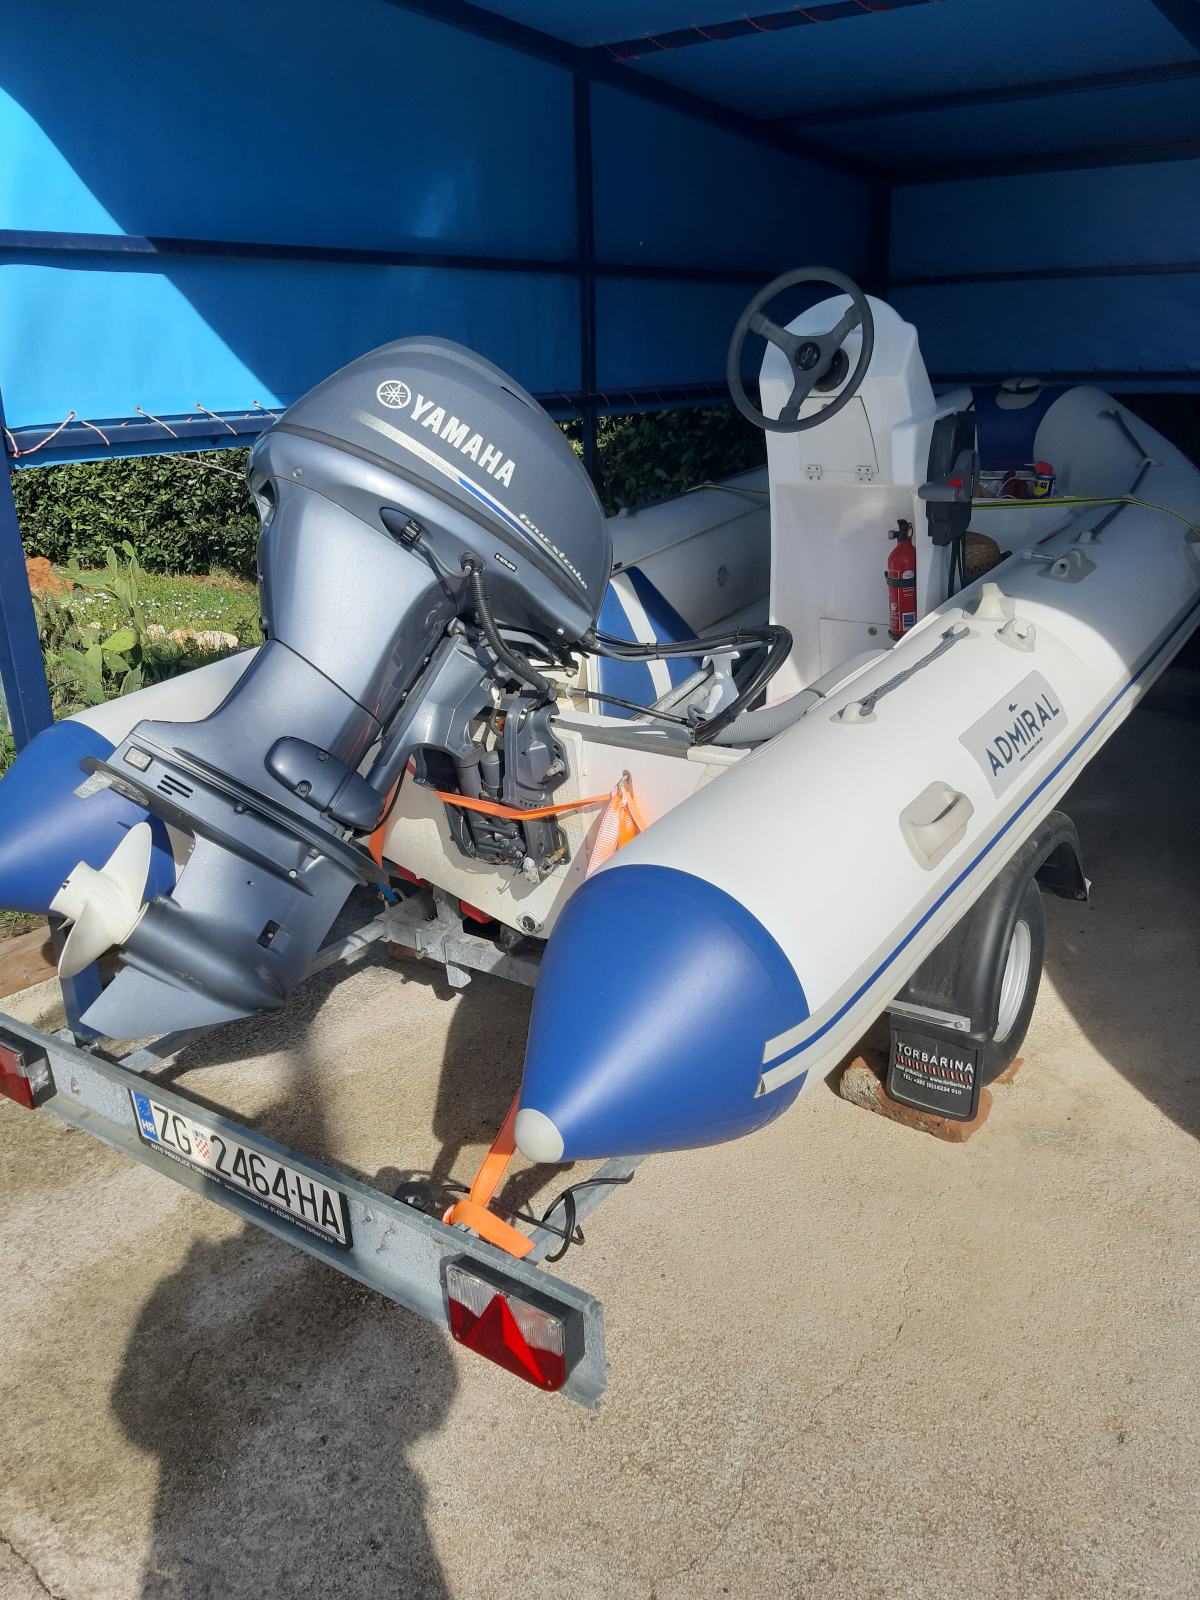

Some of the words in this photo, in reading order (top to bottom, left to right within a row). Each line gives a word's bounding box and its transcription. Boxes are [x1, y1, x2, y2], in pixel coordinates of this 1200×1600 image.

[409, 394, 517, 488] YAMAHA
[985, 693, 1060, 777] ADMIRAL
[897, 1042, 974, 1074] TORBARINA
[141, 1119, 156, 1135] HR
[153, 1105, 192, 1156] ZG
